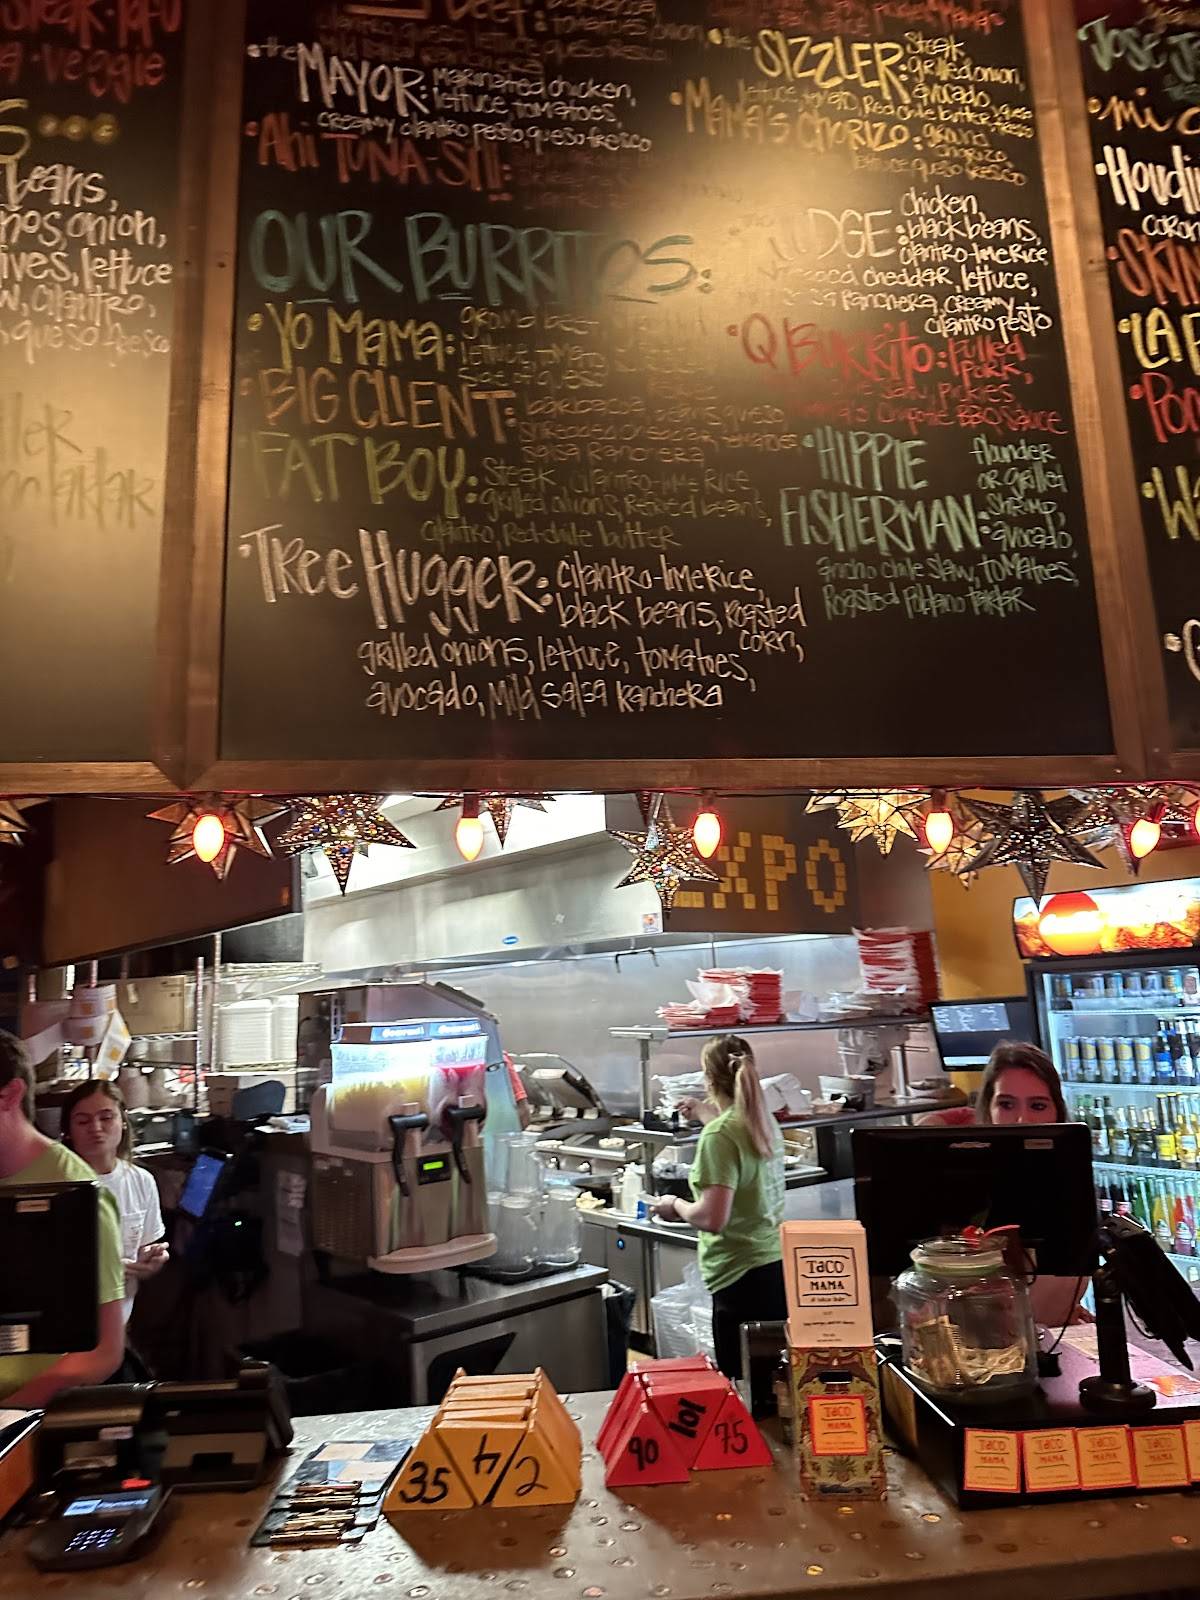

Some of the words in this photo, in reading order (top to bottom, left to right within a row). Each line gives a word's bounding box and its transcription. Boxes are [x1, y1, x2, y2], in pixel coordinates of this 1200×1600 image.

[297, 42, 431, 118] MAYOR:
[753, 29, 912, 106] SIZZLER:
[249, 209, 403, 303] OUR
[350, 368, 518, 444] CLIENT:
[364, 435, 479, 519] BOY:
[816, 425, 929, 492] HIPPIE
[779, 486, 992, 557] FISHERMAN:
[628, 1436, 660, 1472] 90
[714, 1420, 749, 1455] 75
[399, 1460, 452, 1504] 35
